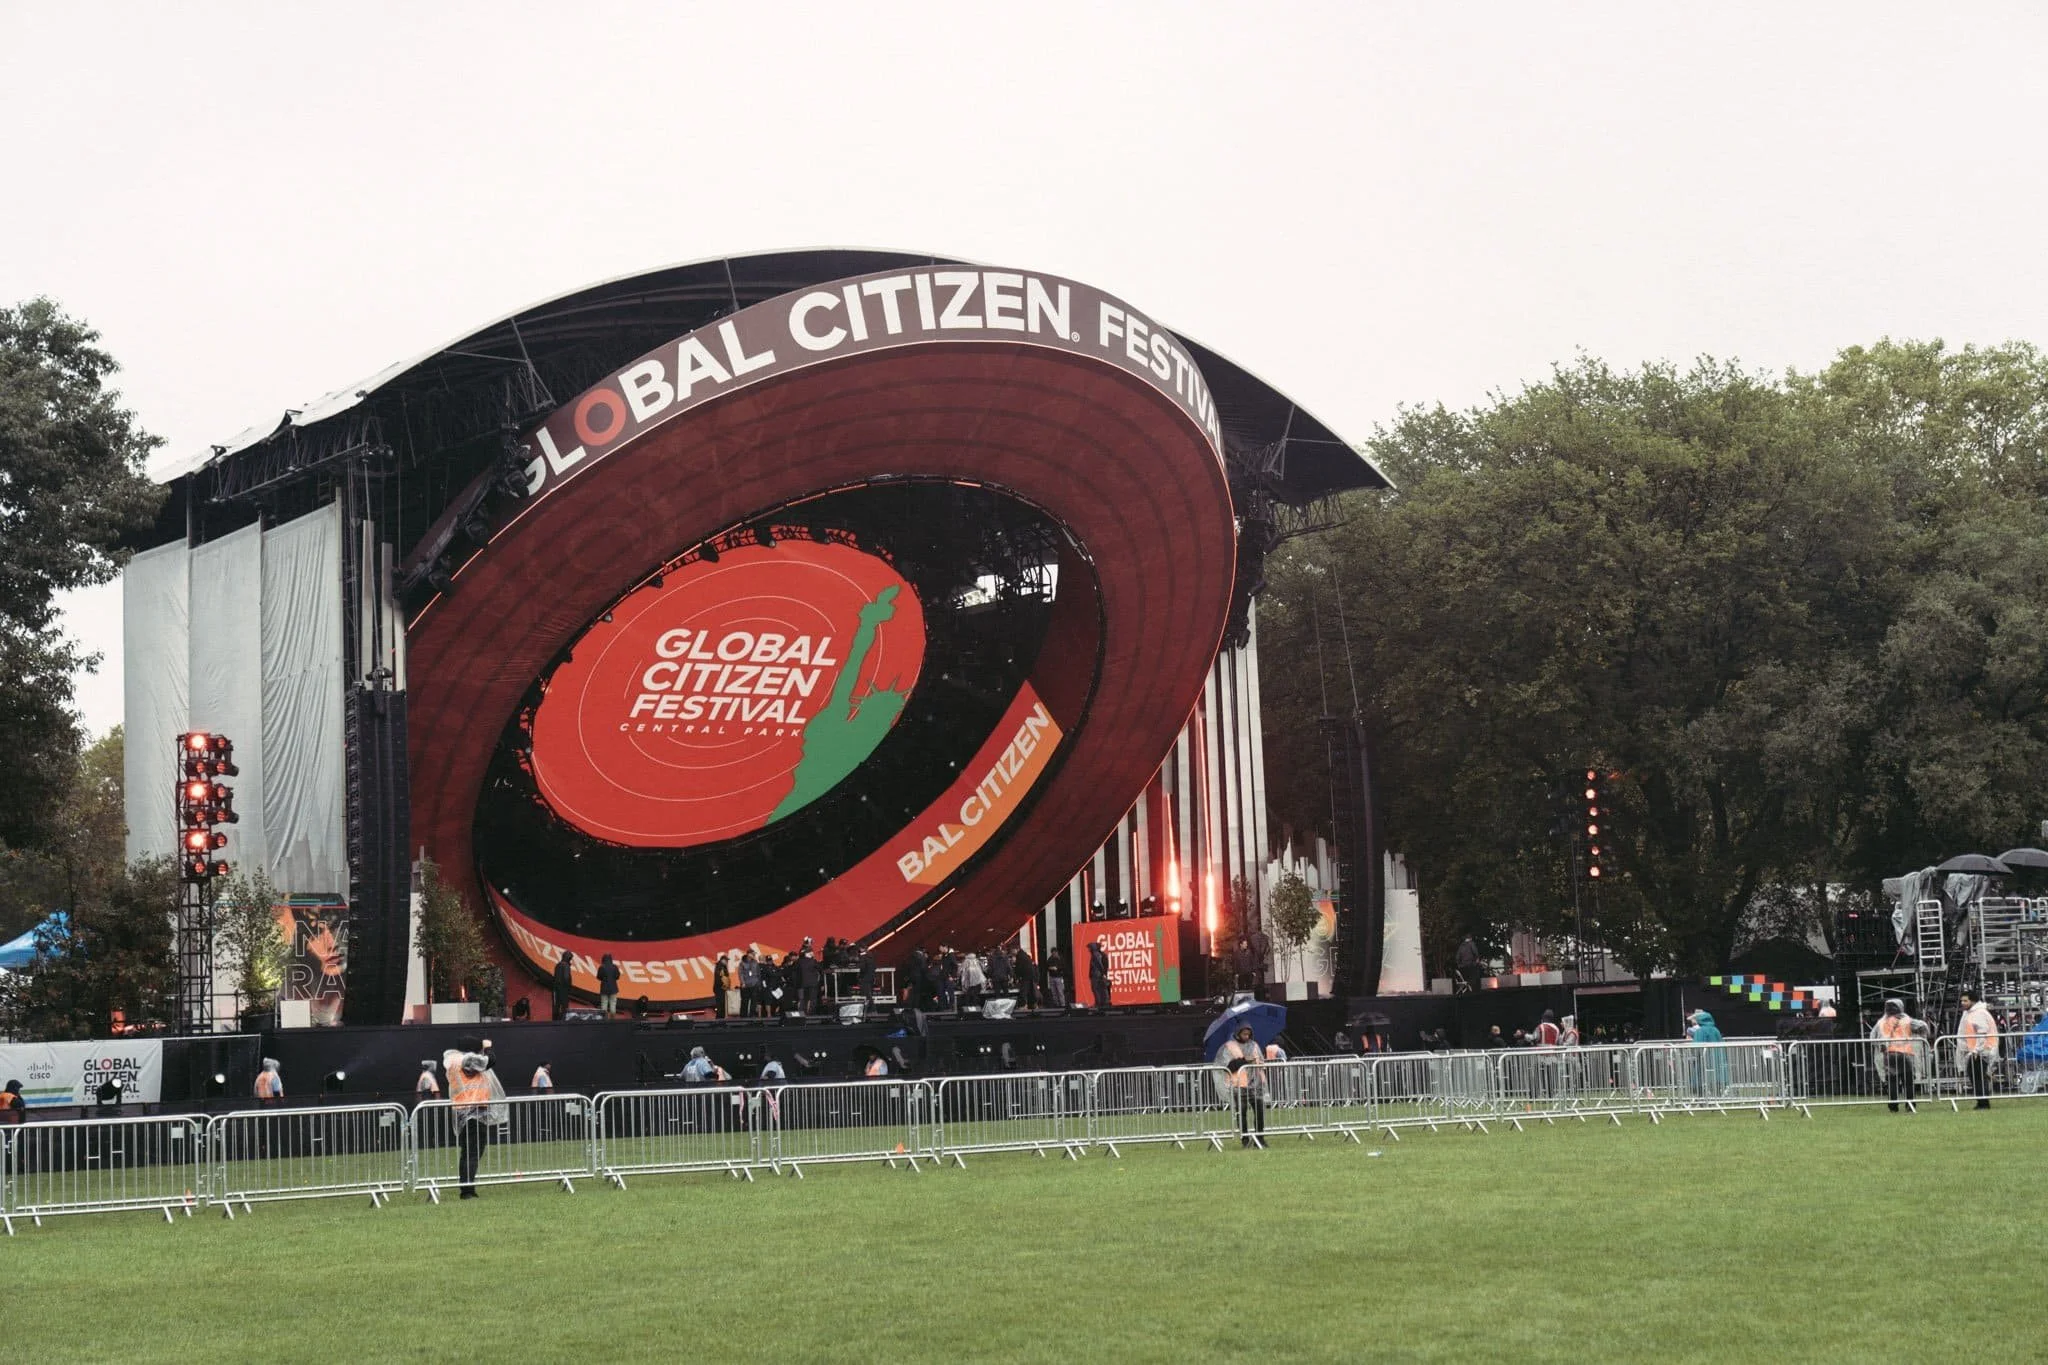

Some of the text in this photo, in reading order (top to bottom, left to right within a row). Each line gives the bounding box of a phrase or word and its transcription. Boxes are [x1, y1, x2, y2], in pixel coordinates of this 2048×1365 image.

[655, 628, 838, 666] GLOBAL
[642, 661, 821, 697] CITIZEN
[629, 694, 807, 724] FESTIVAL
[619, 722, 801, 738] CENTRAL PARK
[896, 702, 1050, 882] BAL CITIZEN
[1096, 930, 1154, 952] GLOBAL
[1107, 949, 1152, 970] ITIZEN
[1107, 968, 1156, 986] ESTIVAL
[83, 1057, 141, 1071] GLOBAL
